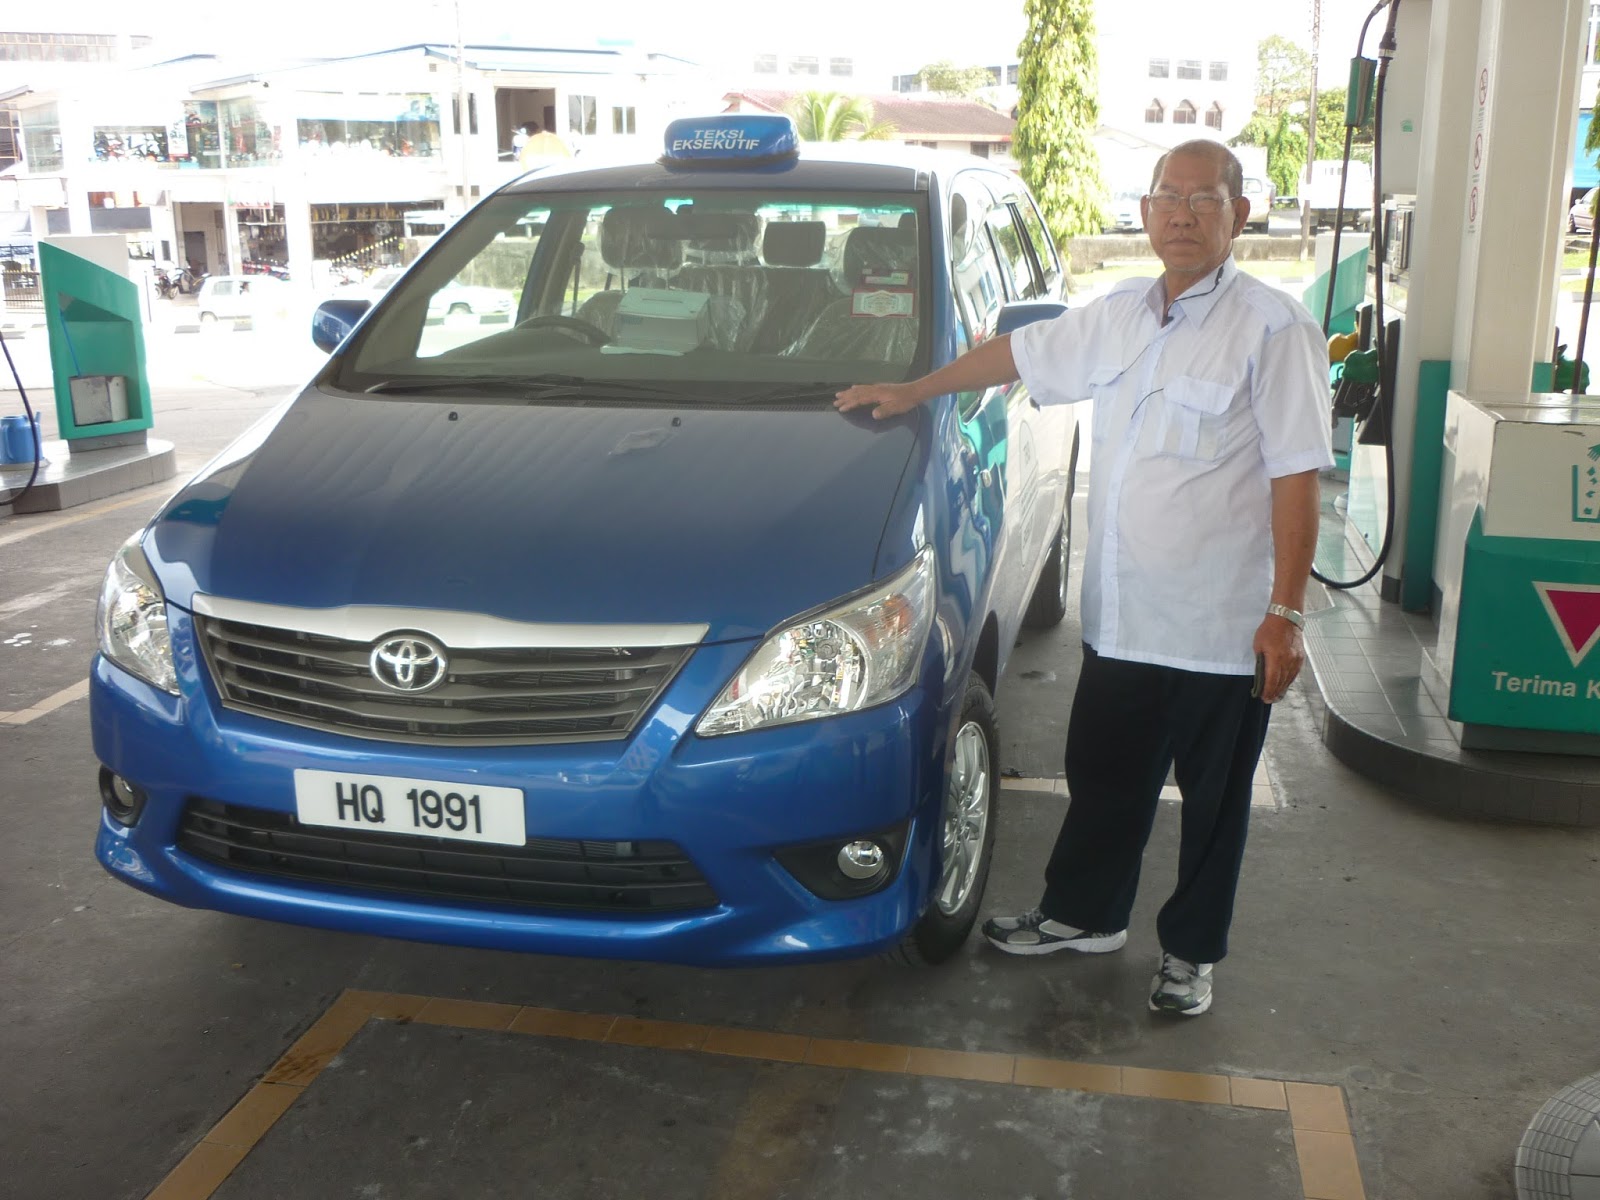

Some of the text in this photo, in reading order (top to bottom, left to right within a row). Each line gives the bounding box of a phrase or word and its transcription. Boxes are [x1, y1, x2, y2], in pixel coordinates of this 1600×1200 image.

[693, 129, 745, 140] TEKSI
[672, 138, 760, 151] EKSEKUTIF
[1491, 671, 1577, 697] Terima
[335, 782, 483, 834] HQ 1991
